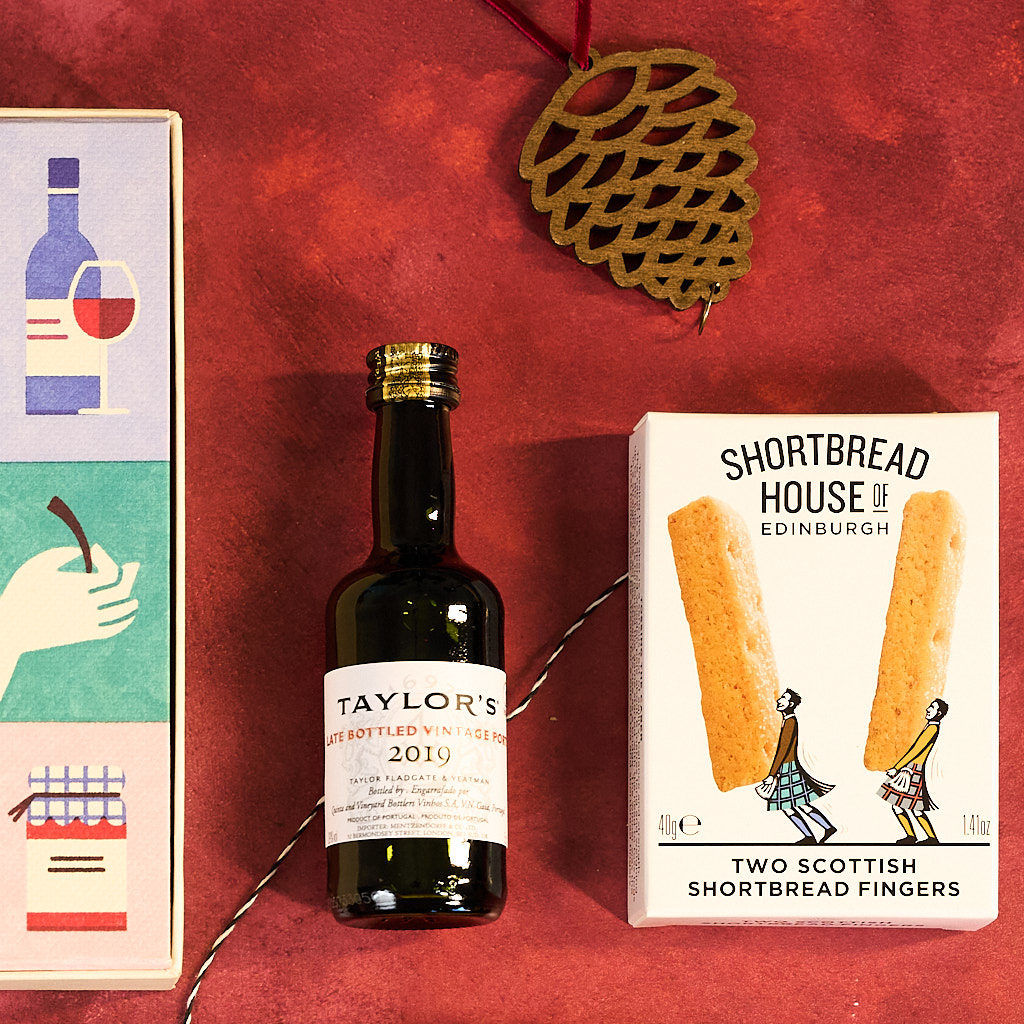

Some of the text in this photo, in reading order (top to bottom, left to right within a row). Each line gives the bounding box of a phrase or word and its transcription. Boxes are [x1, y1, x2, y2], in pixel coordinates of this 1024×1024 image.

[720, 433, 930, 481] SHORTBREAD
[761, 480, 889, 514] HOUSE OF
[761, 522, 890, 536] EDINBURGH
[337, 692, 497, 716] TAYLOR'S
[326, 731, 344, 747] LATE
[348, 725, 417, 741] BOTTLED
[423, 726, 489, 741] VINTAGE
[388, 745, 451, 768] 2019
[349, 776, 381, 785] TAYLOR
[386, 774, 437, 782] FLADGATE
[395, 785, 404, 795] by
[963, 814, 991, 836] 1.41oz
[731, 858, 917, 875] TWO SCOTTISH
[688, 881, 960, 898] SHORTBREAD FINGERS
